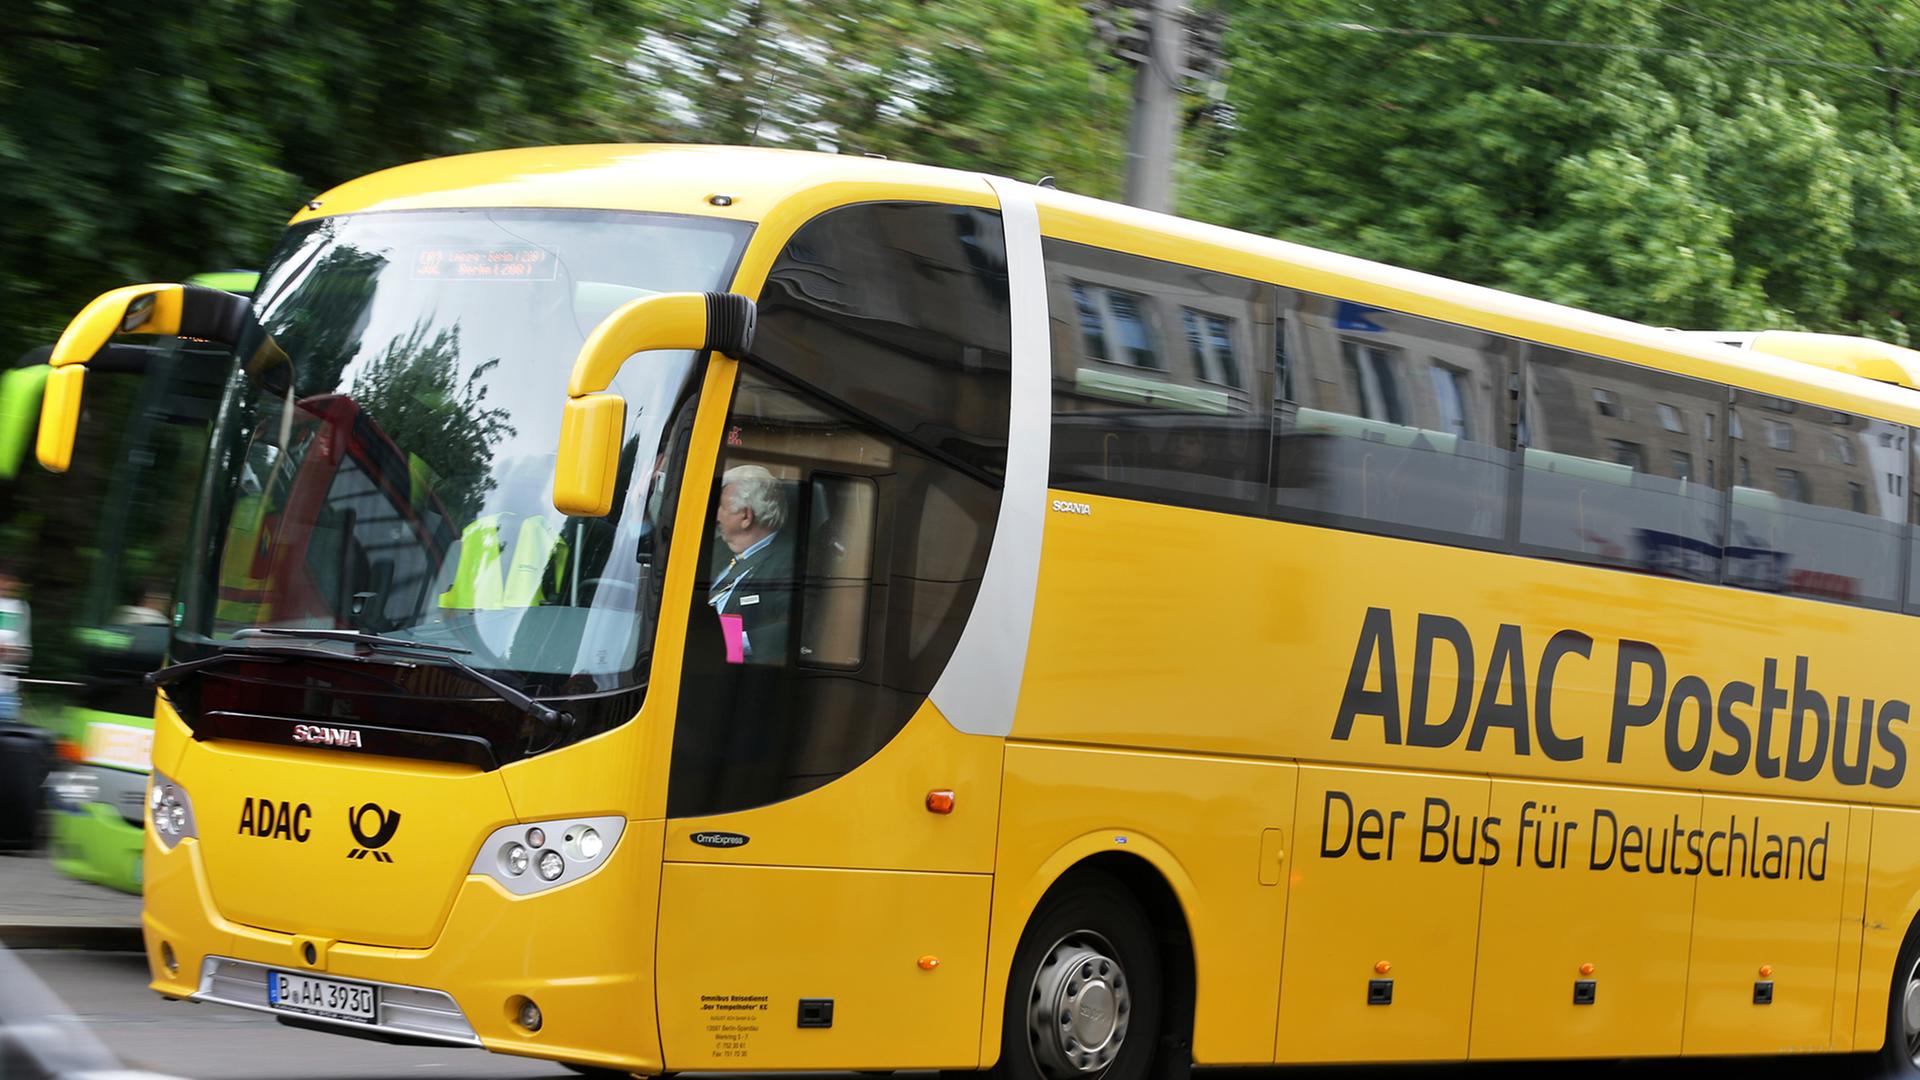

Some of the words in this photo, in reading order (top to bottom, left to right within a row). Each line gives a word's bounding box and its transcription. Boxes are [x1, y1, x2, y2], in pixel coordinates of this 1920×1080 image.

[1052, 500, 1091, 515] SCANIA
[1331, 606, 1594, 761] ADAC
[1606, 639, 1910, 789] Postbus
[292, 724, 362, 748] SCANIA
[238, 797, 312, 843] ADAC
[1320, 790, 1405, 862] Der
[1419, 797, 1501, 865] Bus
[1516, 801, 1578, 869] für
[1589, 808, 1830, 881] Deutschland
[697, 834, 743, 845] OmniExpress
[280, 976, 289, 1000] B
[302, 981, 323, 1006] AA
[328, 984, 371, 1013] 3930
